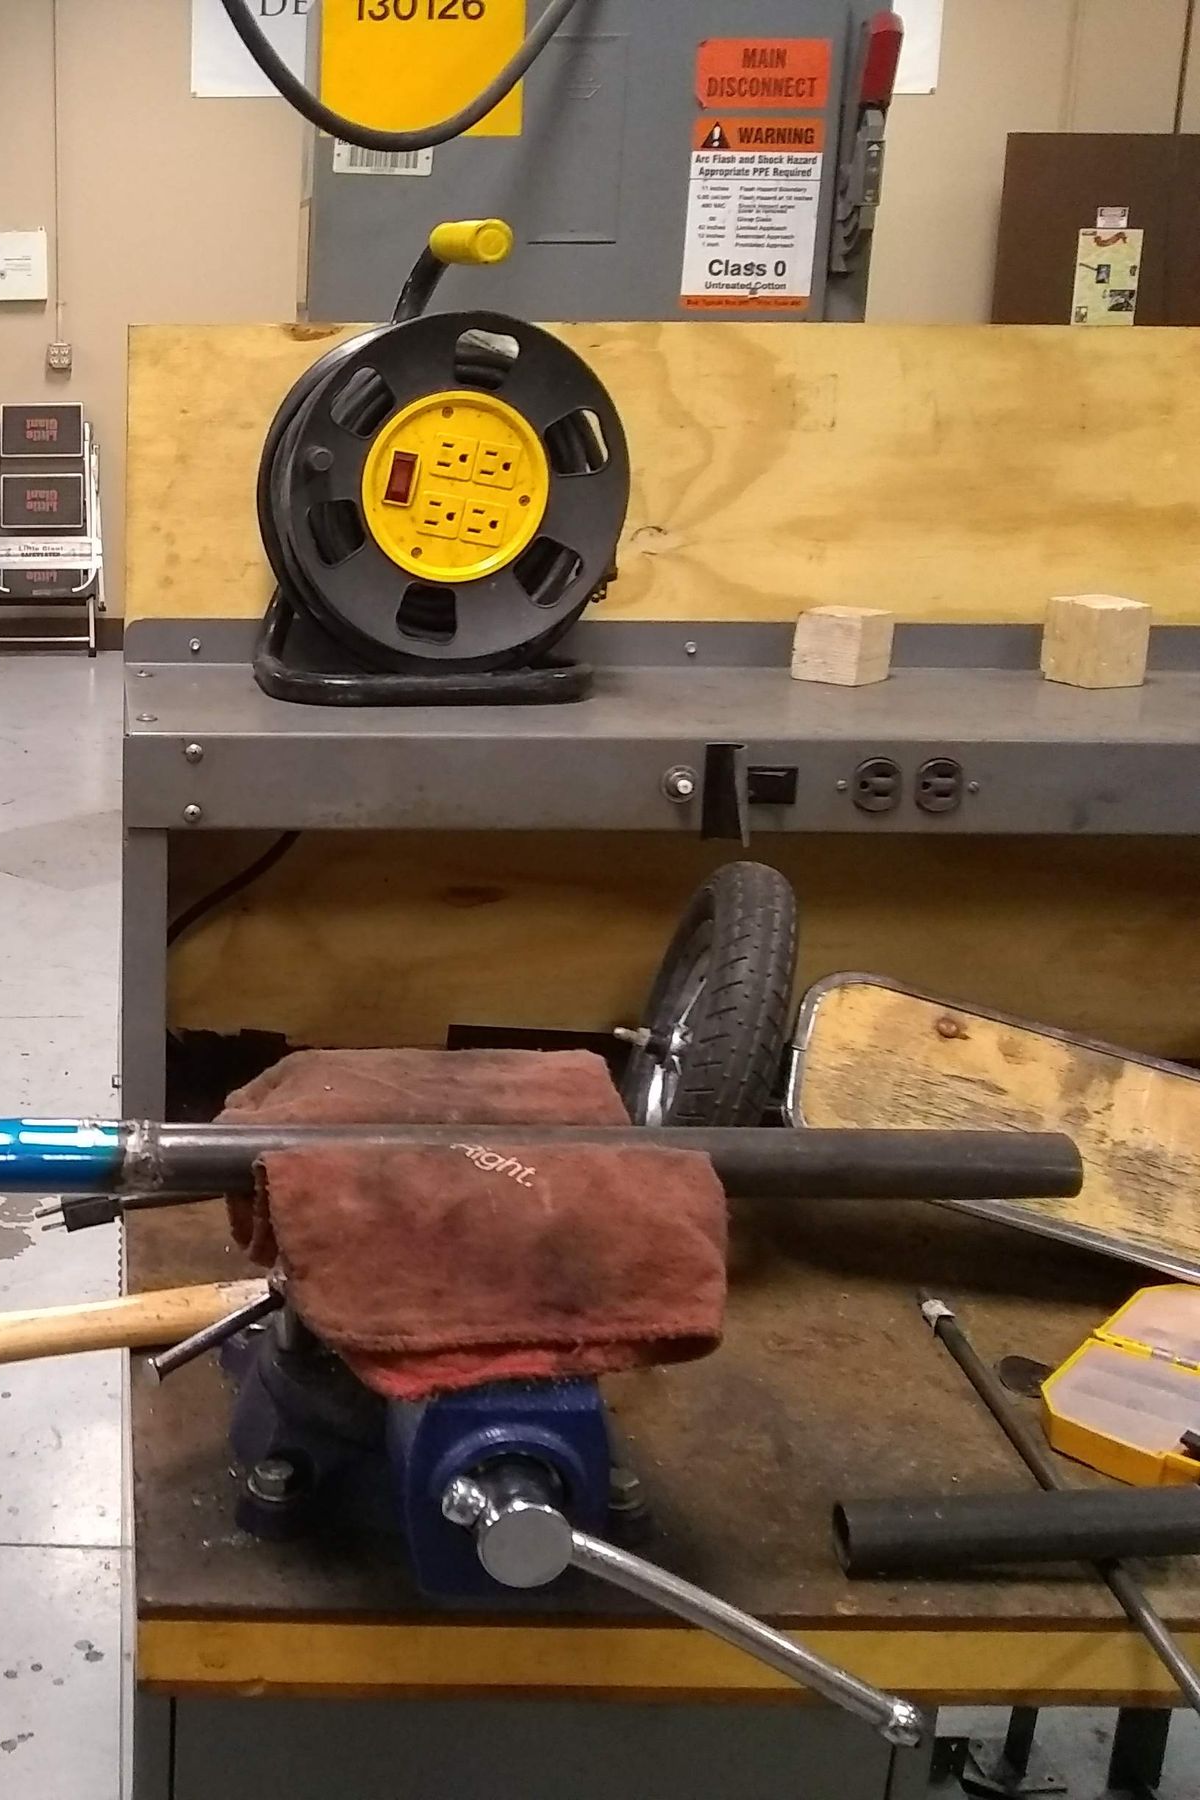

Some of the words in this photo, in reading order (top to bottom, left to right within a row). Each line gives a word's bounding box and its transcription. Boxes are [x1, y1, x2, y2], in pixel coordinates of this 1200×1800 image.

[742, 48, 788, 69] MAIN
[706, 77, 817, 98] DISCONNECT
[738, 127, 815, 145] WARNING
[695, 155, 710, 164] Arc
[712, 155, 736, 164] Flash
[739, 155, 755, 164] and
[758, 155, 784, 165] Shock
[787, 155, 818, 165] Hazard
[699, 167, 750, 177] Appropriate
[752, 167, 770, 177] PPE
[772, 168, 812, 178] Required
[708, 259, 767, 277] Class
[705, 281, 751, 290] Untreated
[754, 281, 787, 290] Cotton
